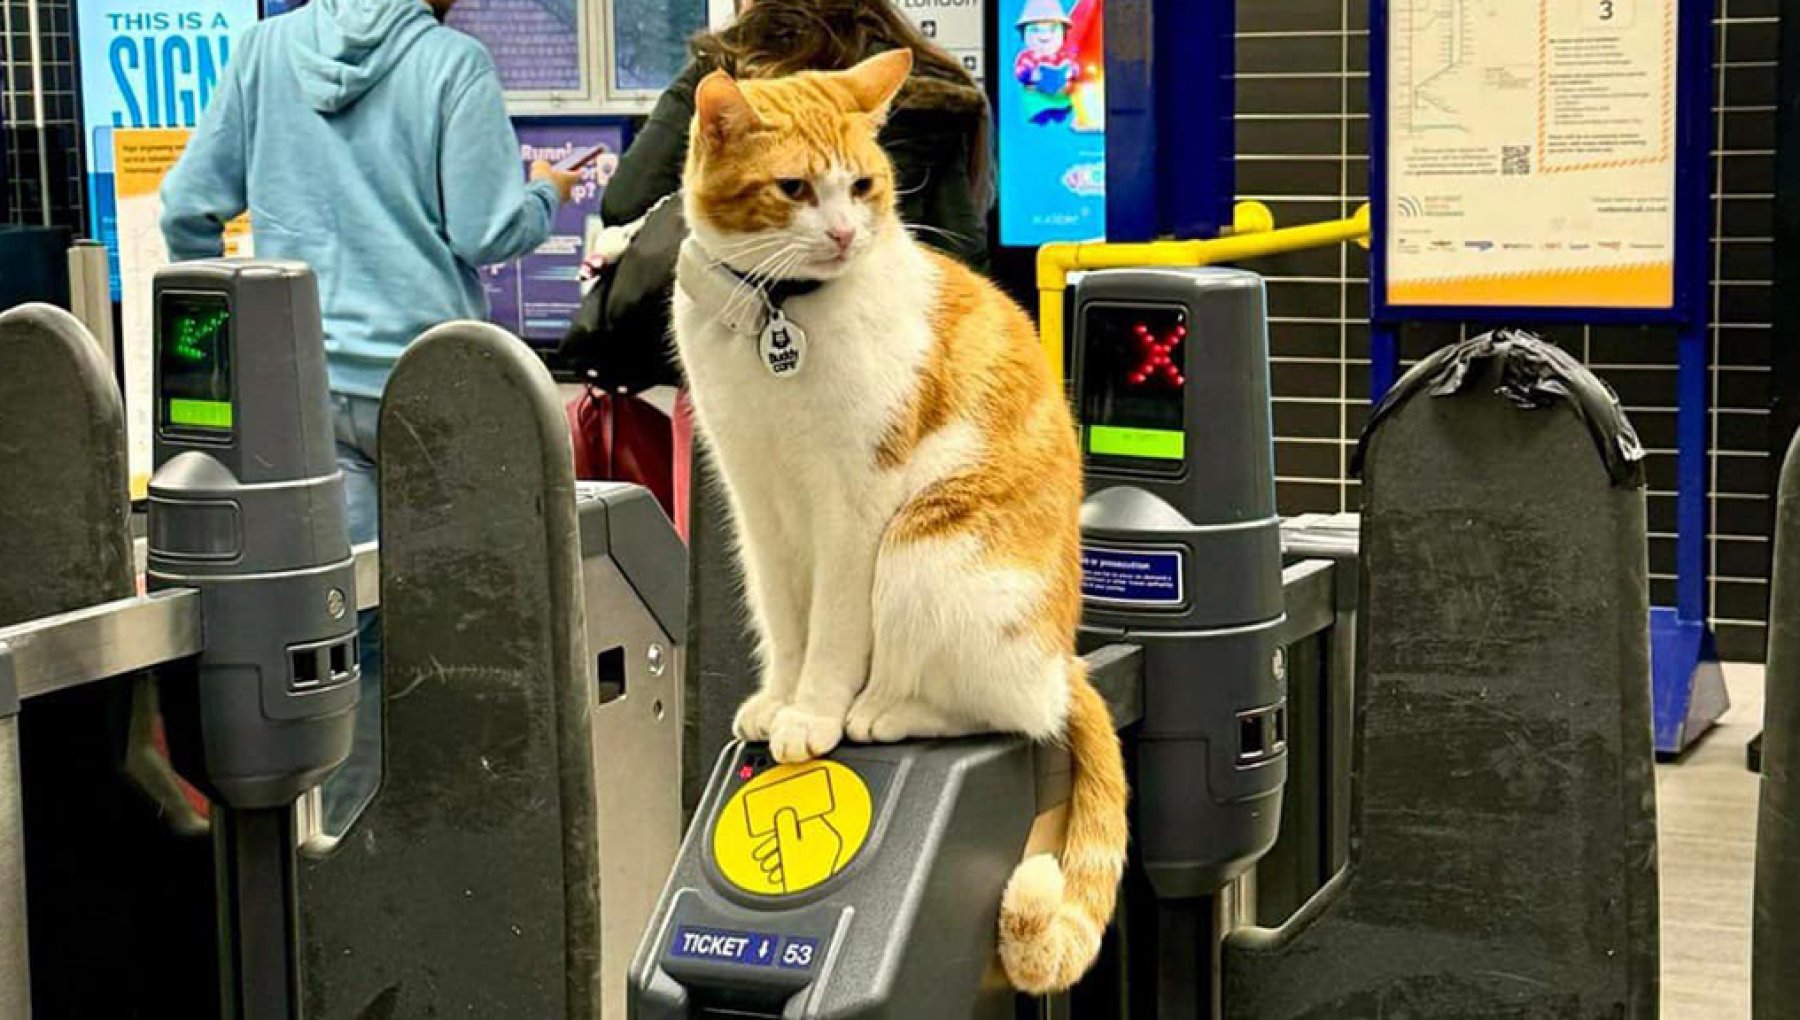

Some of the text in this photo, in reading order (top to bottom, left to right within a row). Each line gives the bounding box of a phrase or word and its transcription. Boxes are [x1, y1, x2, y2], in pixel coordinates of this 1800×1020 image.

[106, 12, 229, 30] THIS IS A
[1598, 0, 1613, 20] 3
[109, 35, 229, 128] SIGN
[683, 932, 750, 958] TICKET
[783, 943, 813, 966] 53
